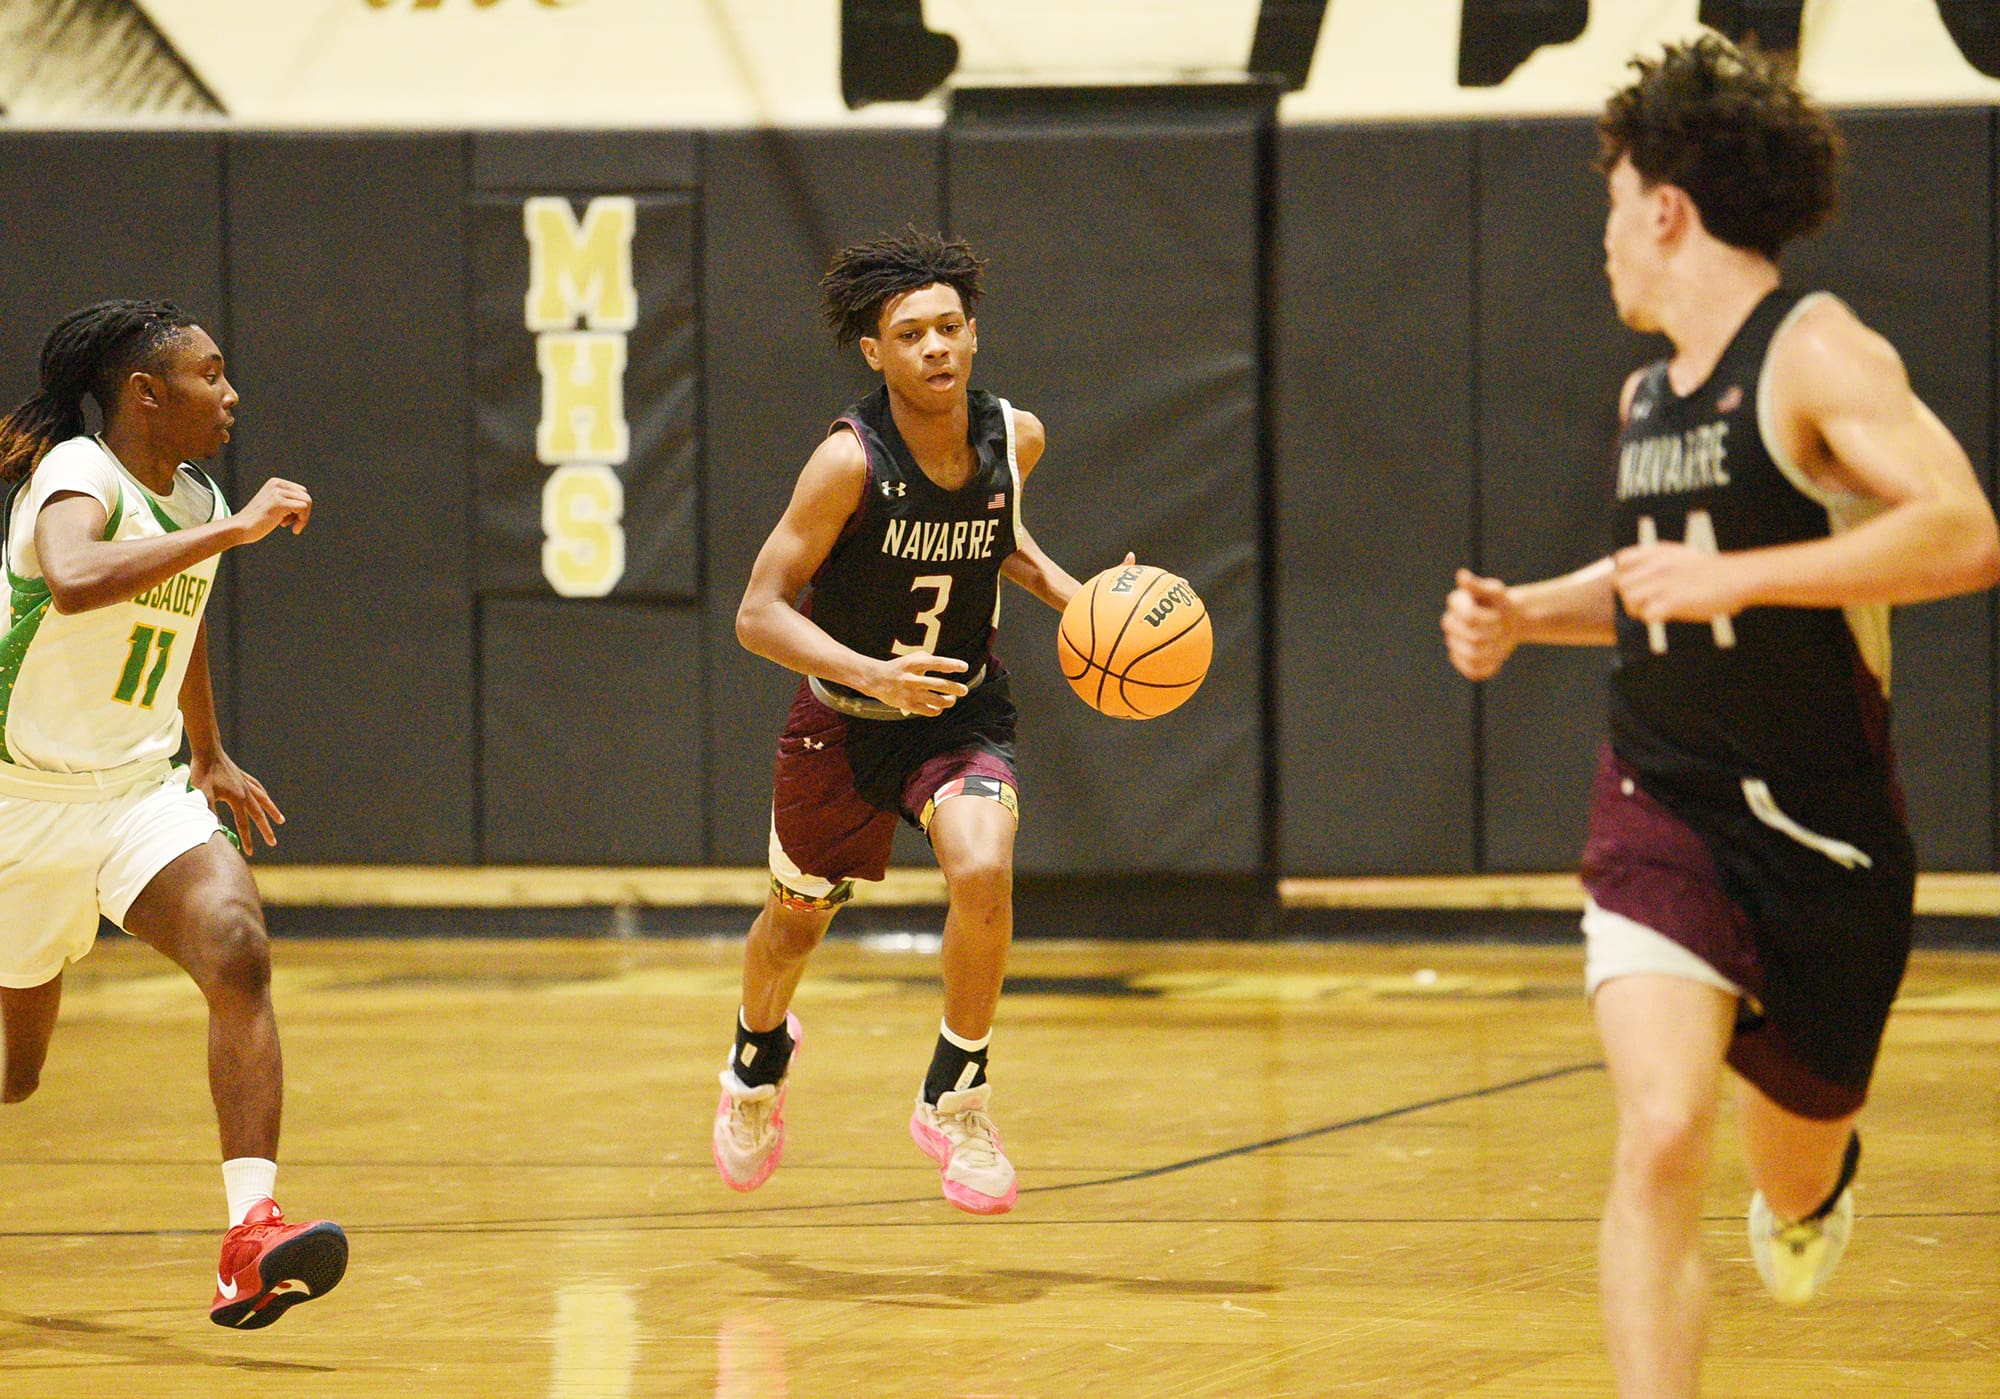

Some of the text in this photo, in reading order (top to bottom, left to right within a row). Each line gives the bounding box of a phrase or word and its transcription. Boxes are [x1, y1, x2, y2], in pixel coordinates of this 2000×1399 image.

[524, 195, 638, 597] MHS
[1615, 422, 1730, 501] NAVARRE
[881, 518, 999, 562] NAVARRE
[1111, 566, 1145, 593] CAA
[891, 575, 953, 657] 3
[1143, 582, 1199, 627] ilson
[111, 621, 177, 711] 11
